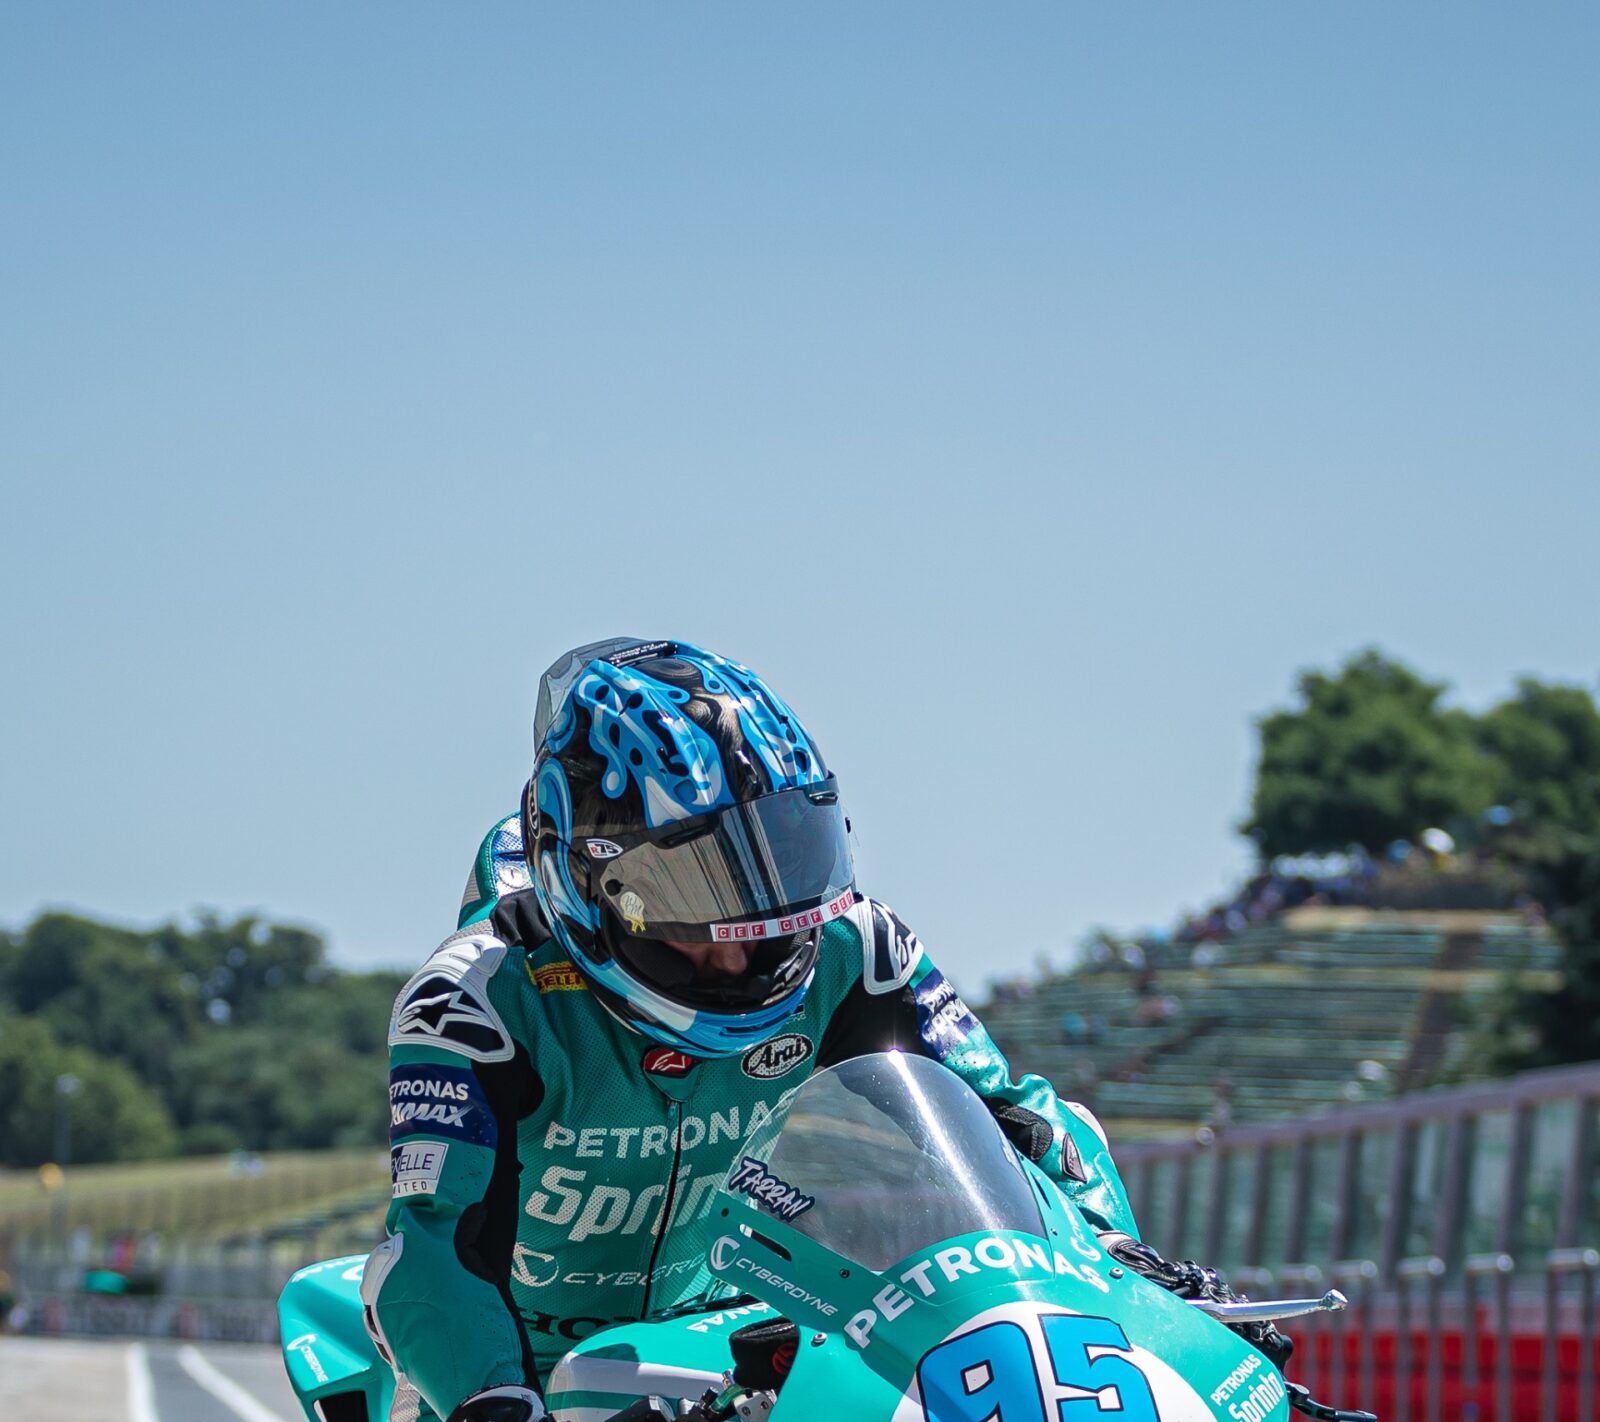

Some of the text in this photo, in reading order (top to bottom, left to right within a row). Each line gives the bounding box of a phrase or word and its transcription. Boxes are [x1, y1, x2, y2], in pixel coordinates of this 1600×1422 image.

[748, 1037, 802, 1071] Arai
[389, 1079, 469, 1101] ETRONAS
[525, 1164, 729, 1242] Sprin
[730, 1158, 811, 1219] TARRAN
[736, 1257, 838, 1317] CYBERDYNE
[843, 1237, 1110, 1349] PETRONAS
[1210, 1353, 1262, 1407] PETRONAS
